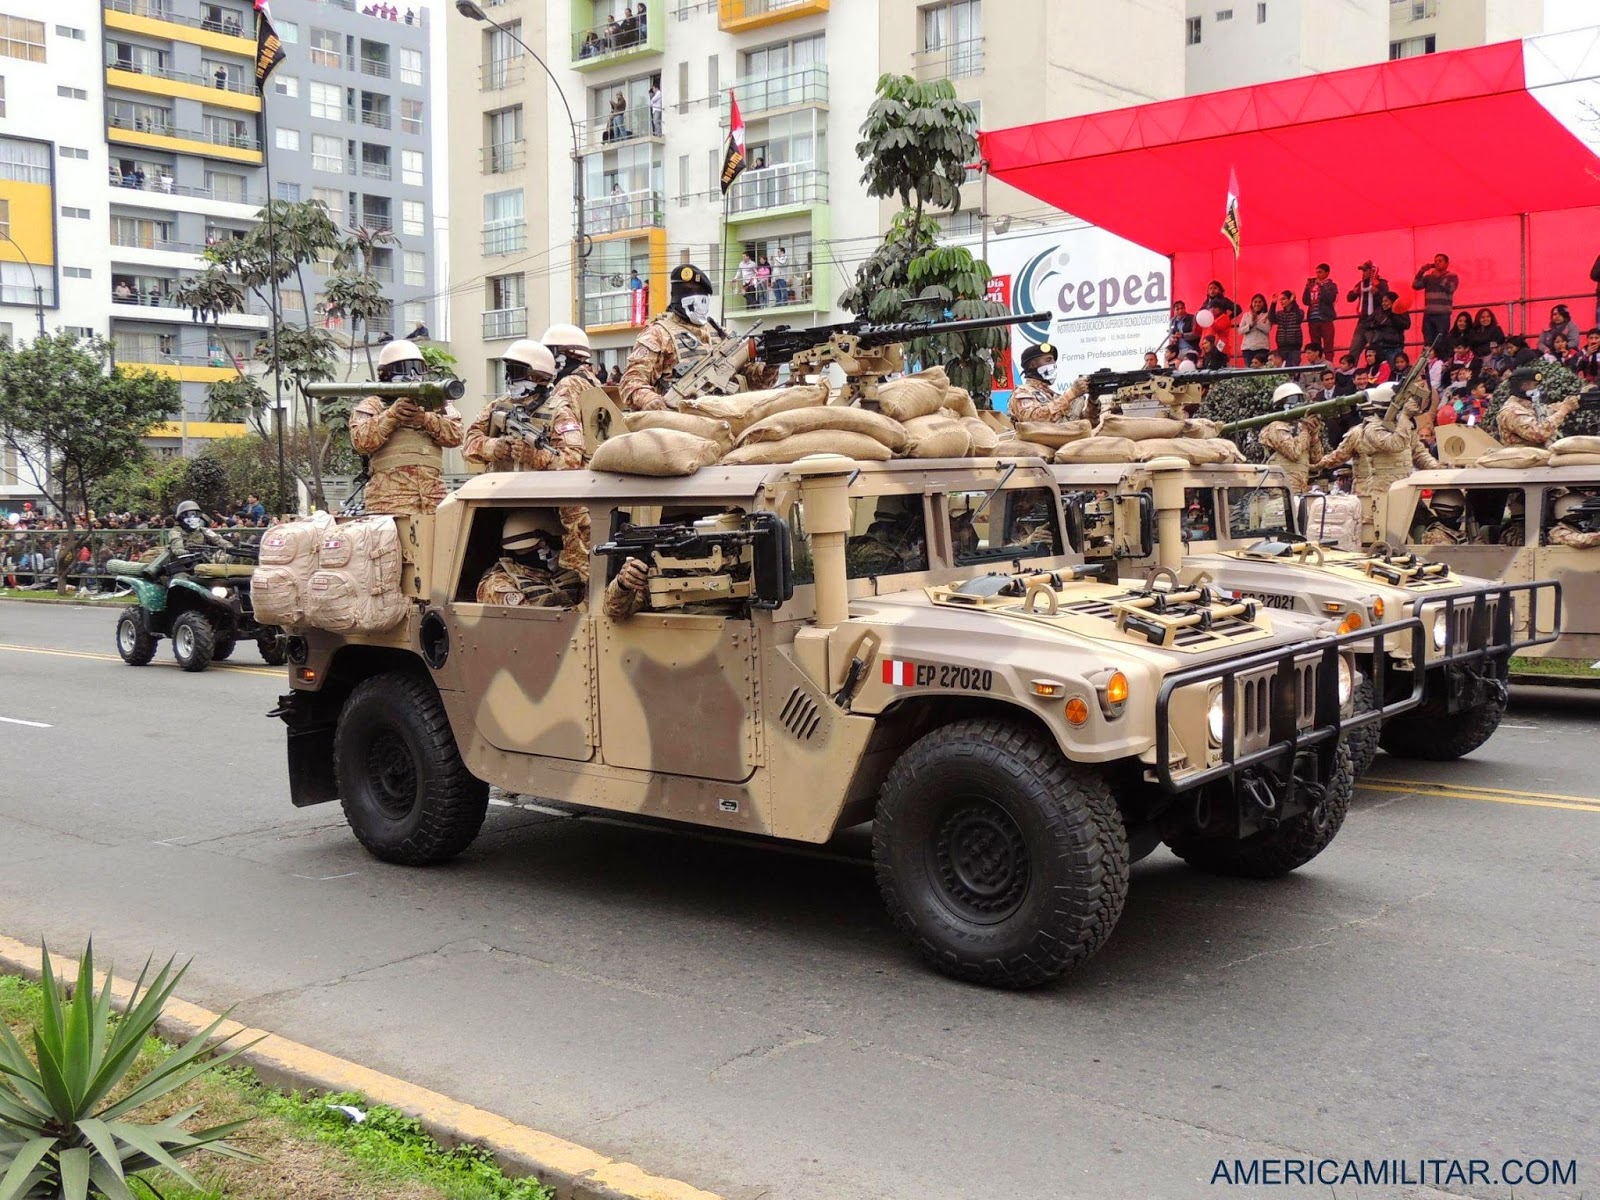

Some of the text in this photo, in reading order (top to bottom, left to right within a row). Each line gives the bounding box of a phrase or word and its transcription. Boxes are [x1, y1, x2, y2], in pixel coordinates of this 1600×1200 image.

[1057, 271, 1167, 315] cepea
[1061, 353, 1085, 362] Forma
[1087, 347, 1138, 360] Profesionales
[916, 664, 992, 691] EP 27020
